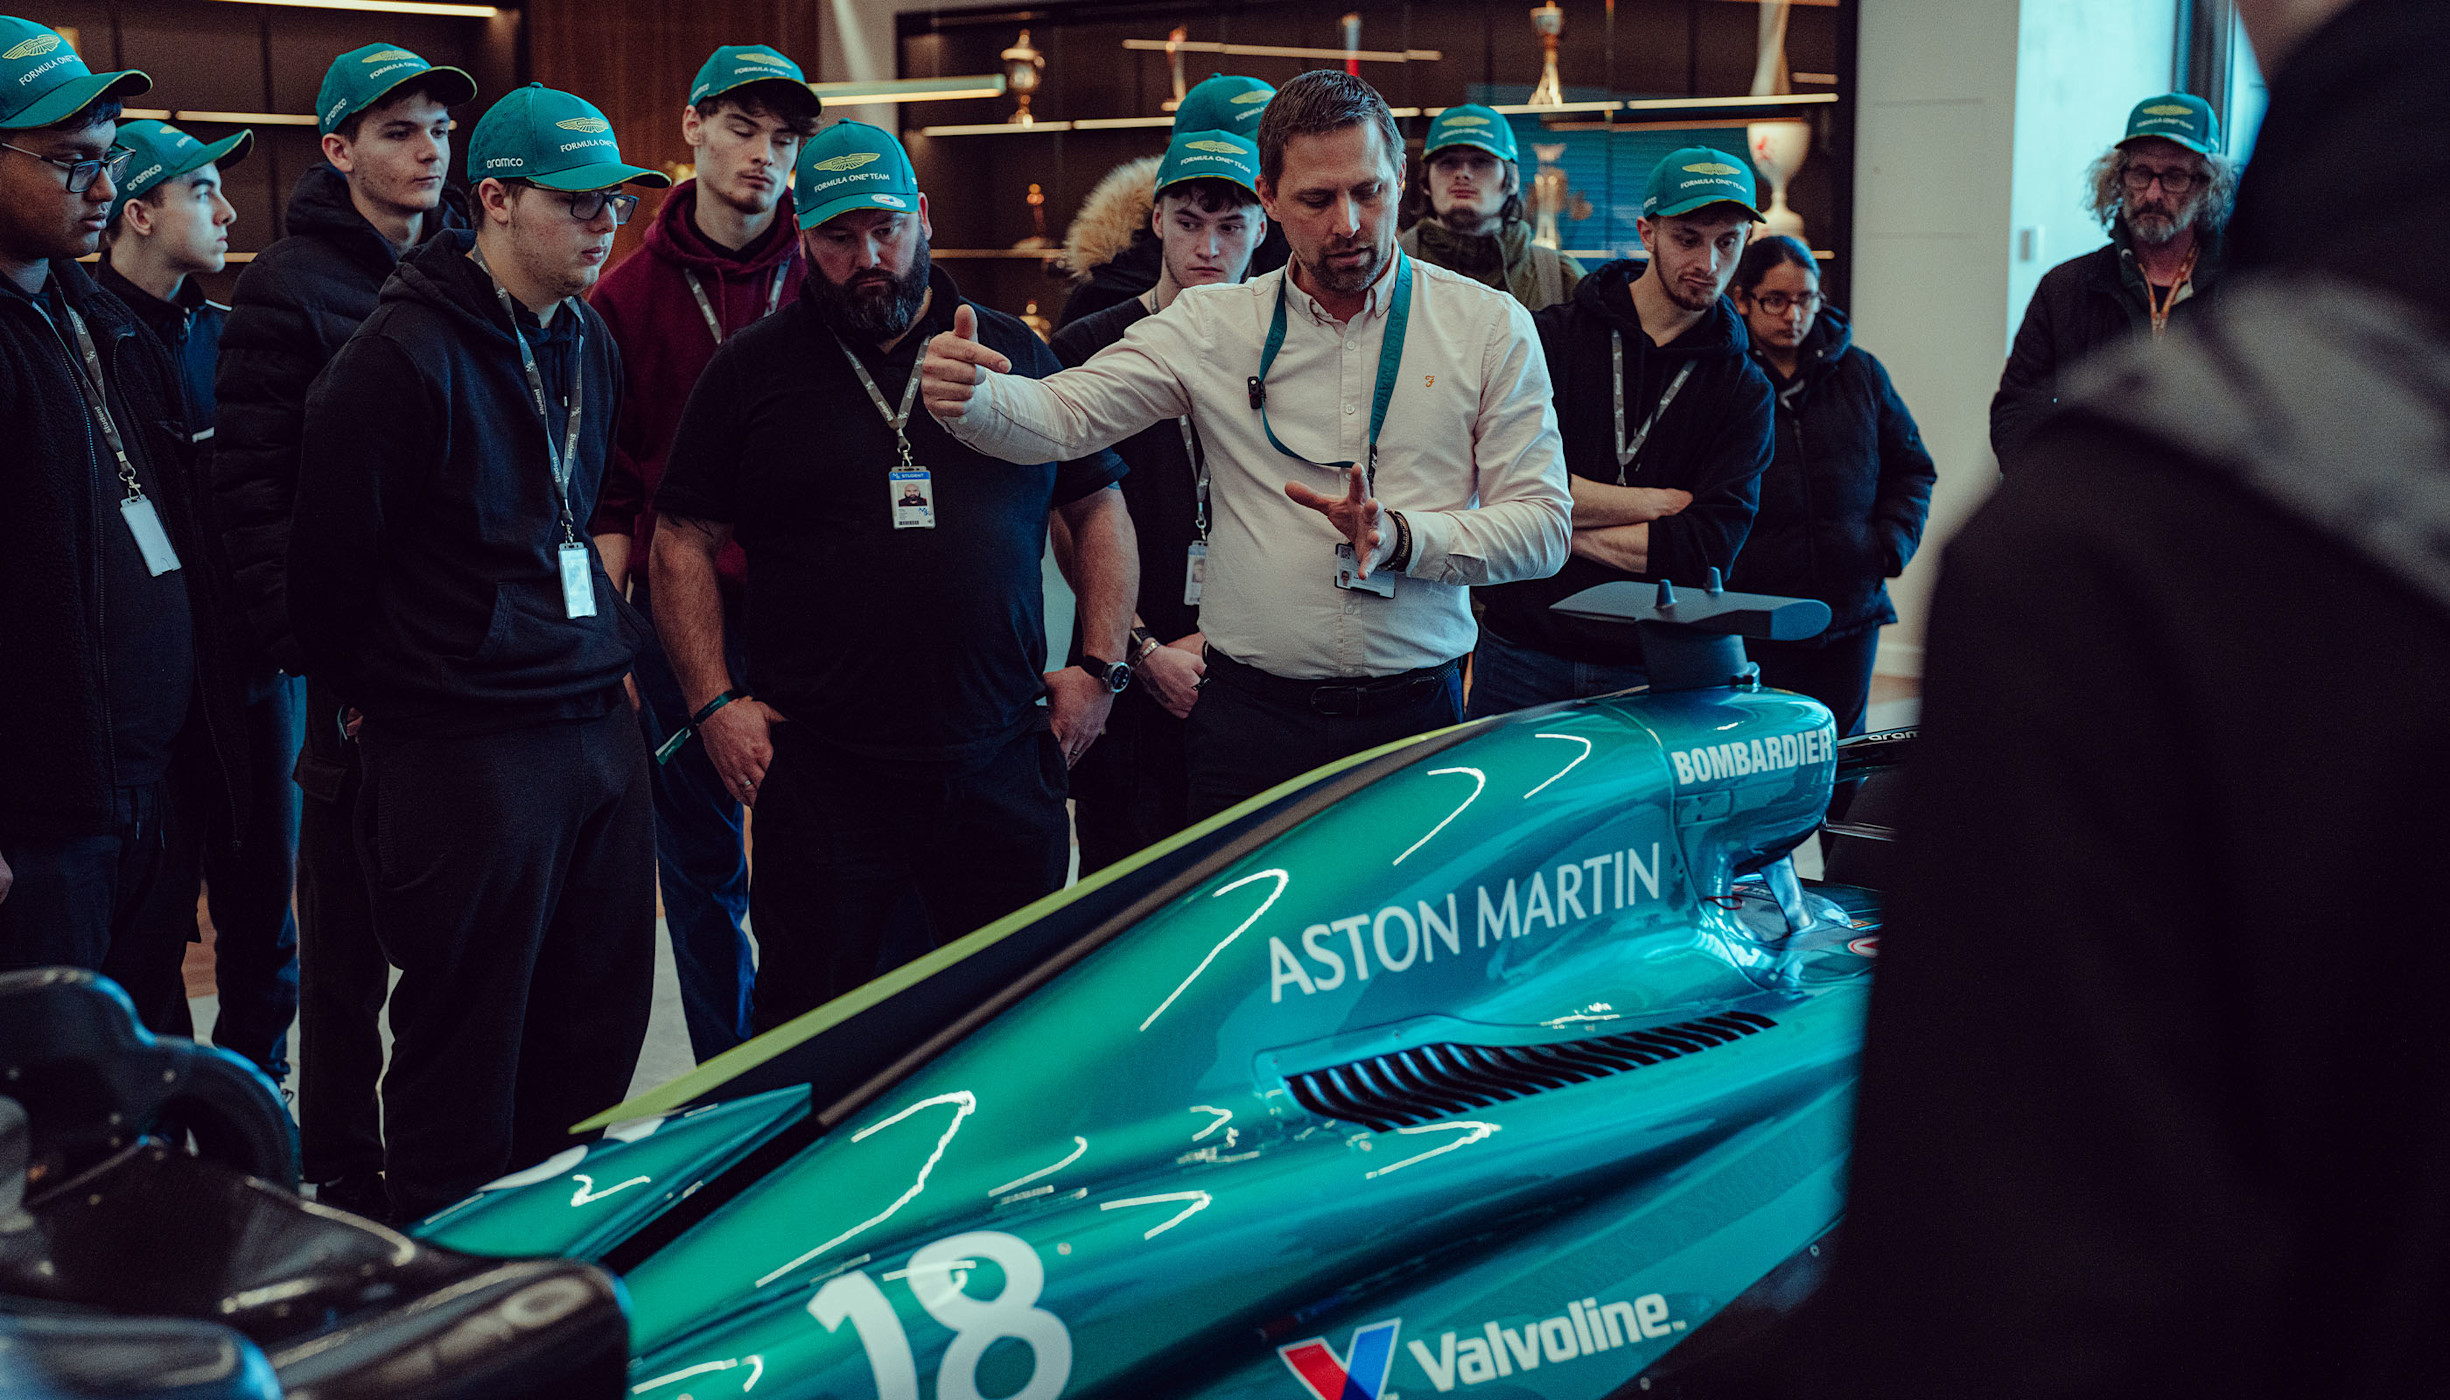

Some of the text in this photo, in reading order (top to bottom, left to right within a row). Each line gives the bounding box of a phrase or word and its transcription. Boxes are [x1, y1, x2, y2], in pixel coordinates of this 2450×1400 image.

[19, 60, 58, 86] FORMULA
[369, 62, 404, 80] FORMULA
[560, 139, 599, 153] FORMULA
[487, 157, 523, 169] aramco
[127, 164, 162, 191] aramco
[814, 176, 848, 193] FORMULA
[869, 172, 890, 181] TEAM
[534, 388, 545, 415] Student
[94, 405, 112, 434] Student
[567, 433, 577, 460] Student
[1671, 728, 1833, 786] BOMBARDIER
[1268, 842, 1662, 1003] ASTON MARTIN
[807, 1230, 1072, 1400] 18
